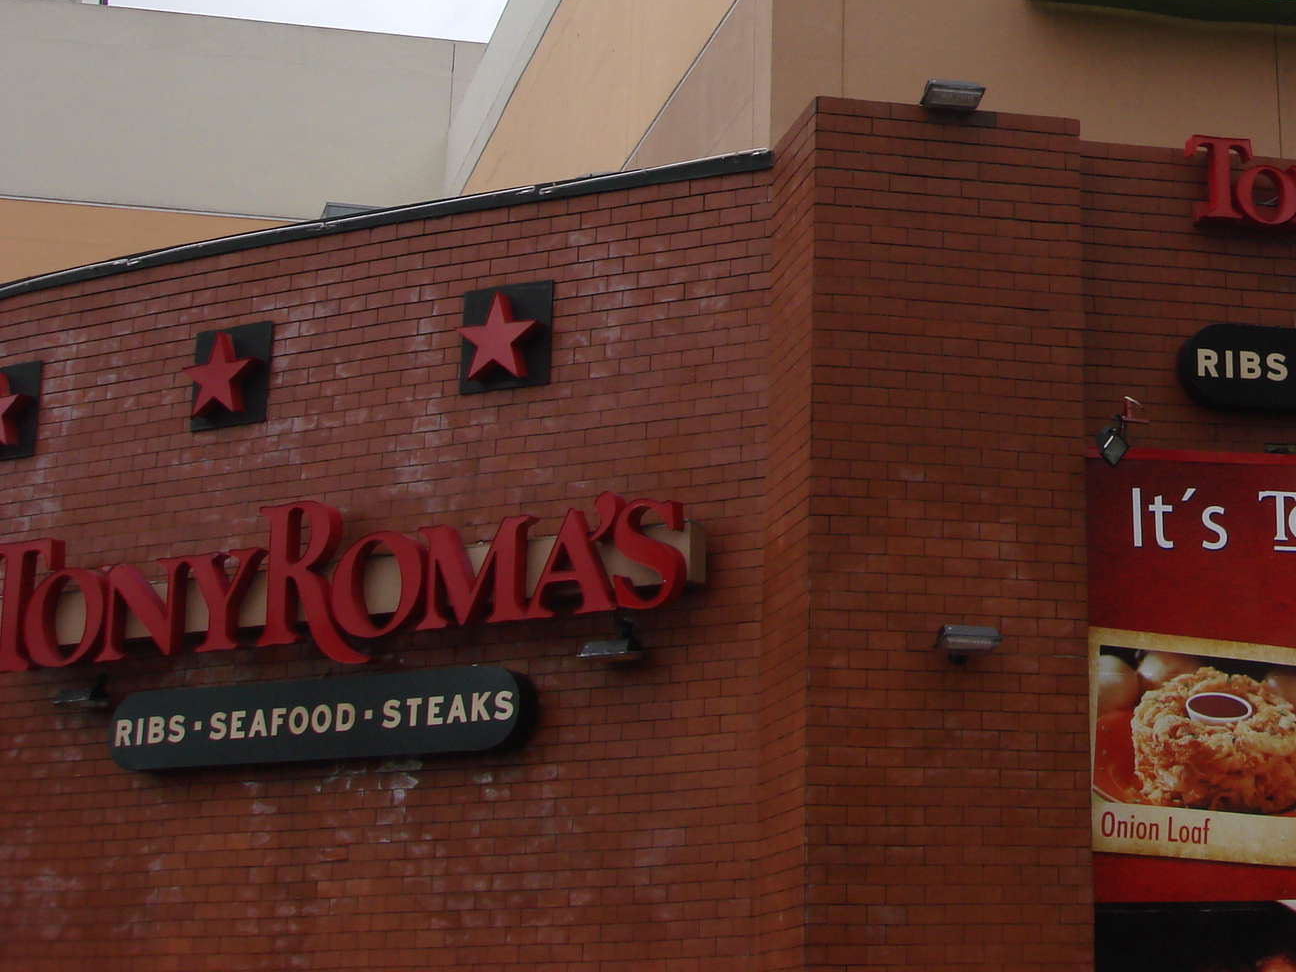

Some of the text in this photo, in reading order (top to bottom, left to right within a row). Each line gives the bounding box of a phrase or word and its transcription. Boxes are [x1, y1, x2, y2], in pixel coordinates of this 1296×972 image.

[1197, 348, 1288, 382] RIBS
[113, 690, 515, 748] RIBS SEAFOOD STEAKS
[1100, 811, 1211, 845] Onion Loaf
